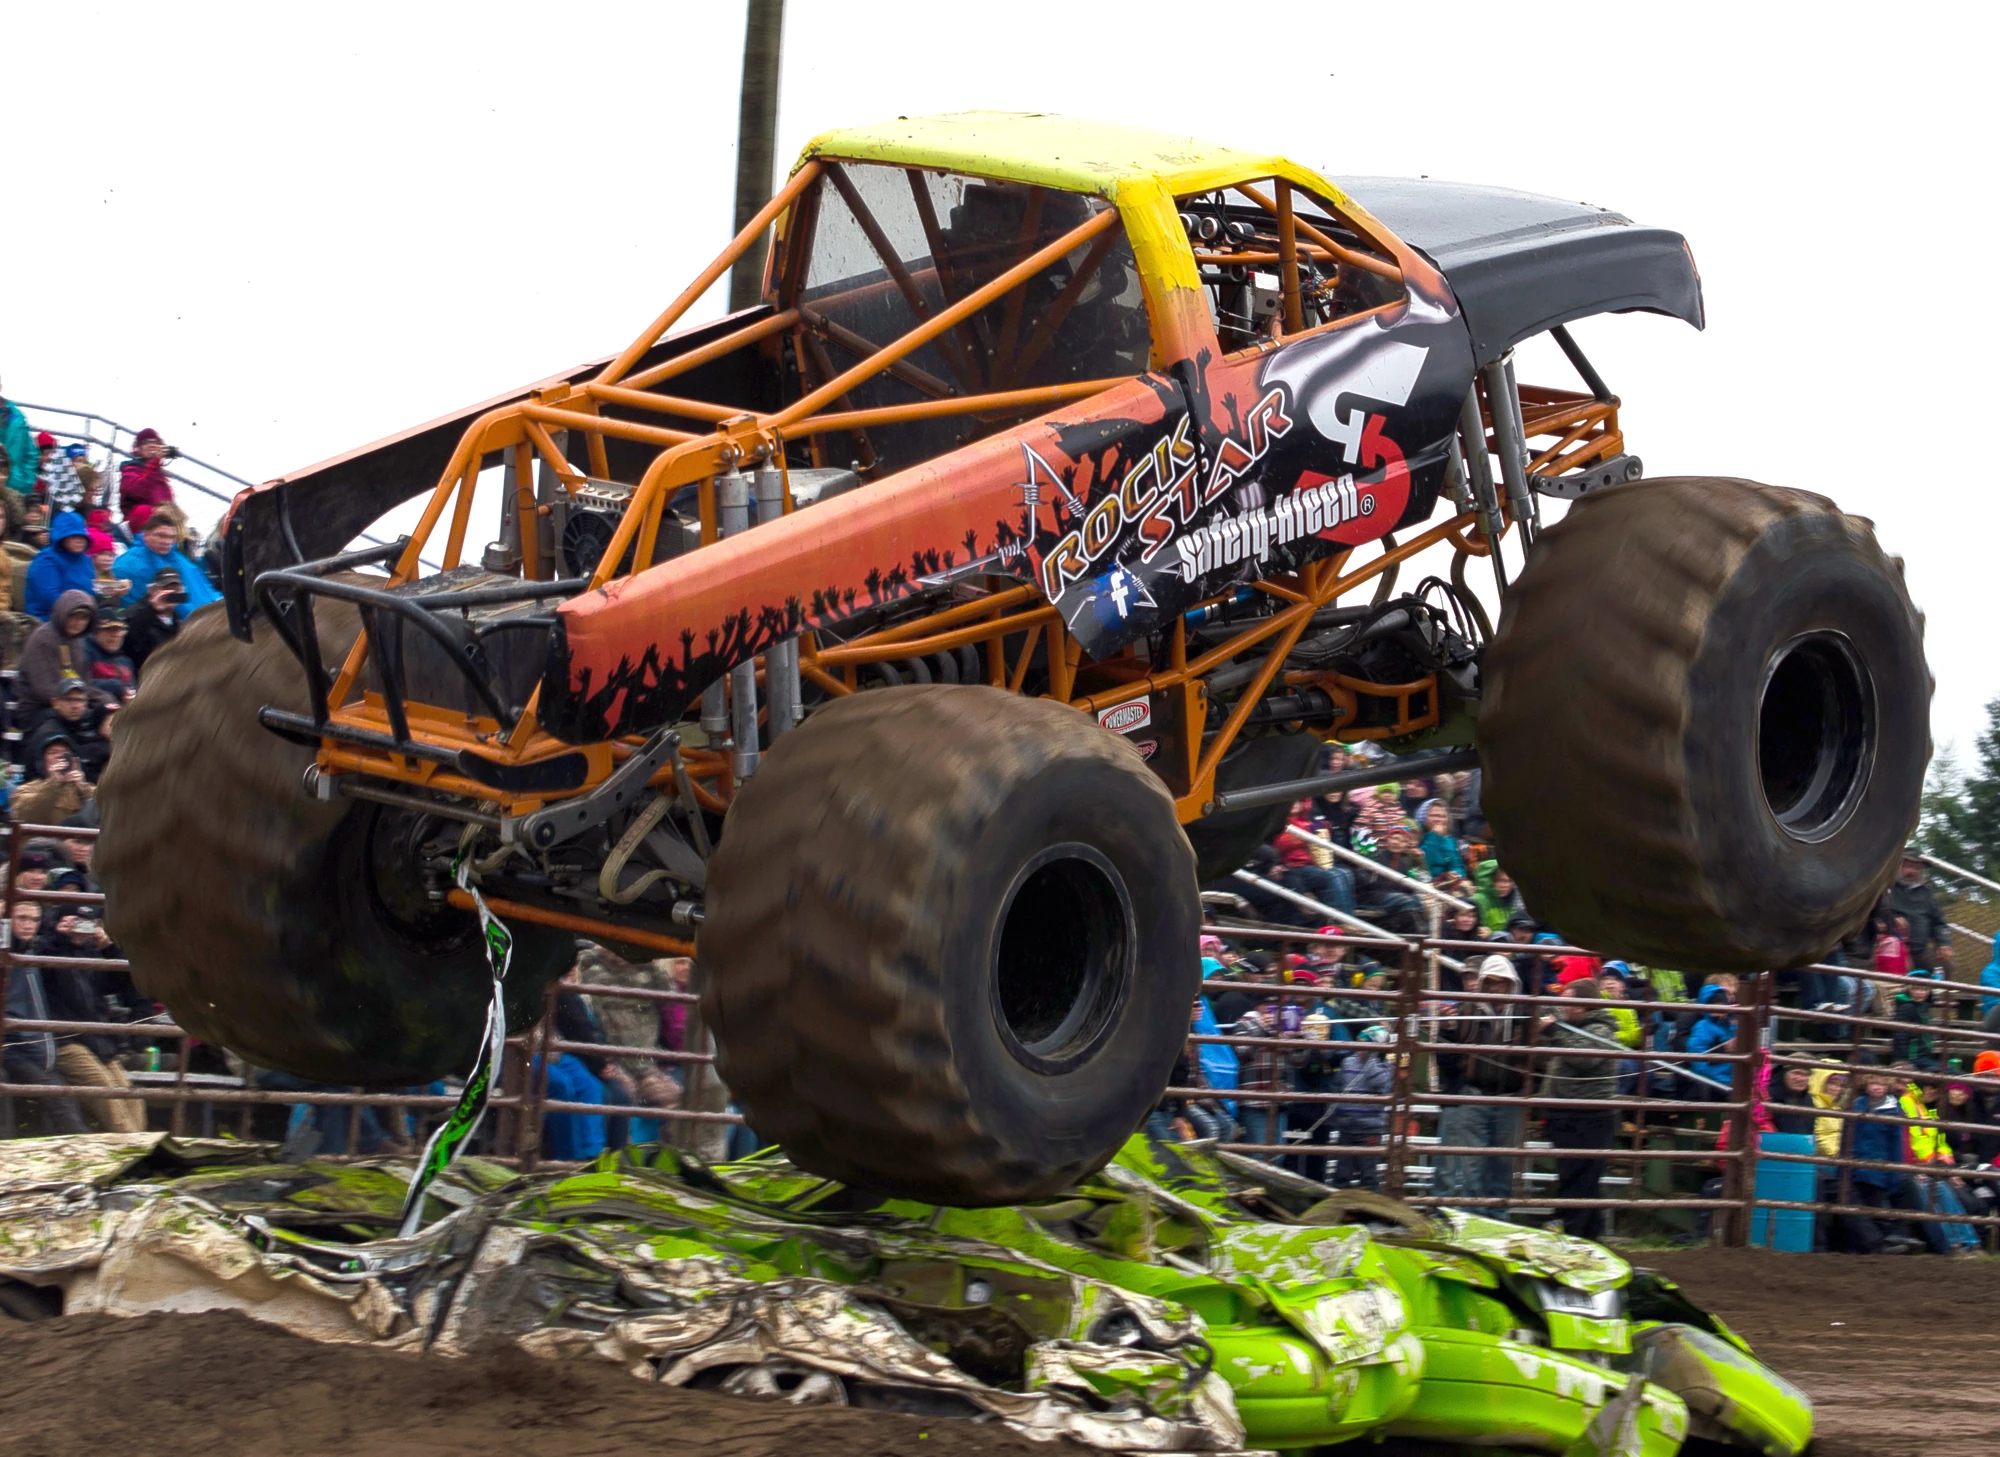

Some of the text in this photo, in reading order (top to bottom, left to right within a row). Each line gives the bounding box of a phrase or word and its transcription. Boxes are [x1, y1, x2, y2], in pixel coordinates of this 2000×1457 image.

[1043, 412, 1206, 604] ROCK
[1138, 388, 1294, 564] STAR
[1105, 705, 1144, 729] POWERMASTER
